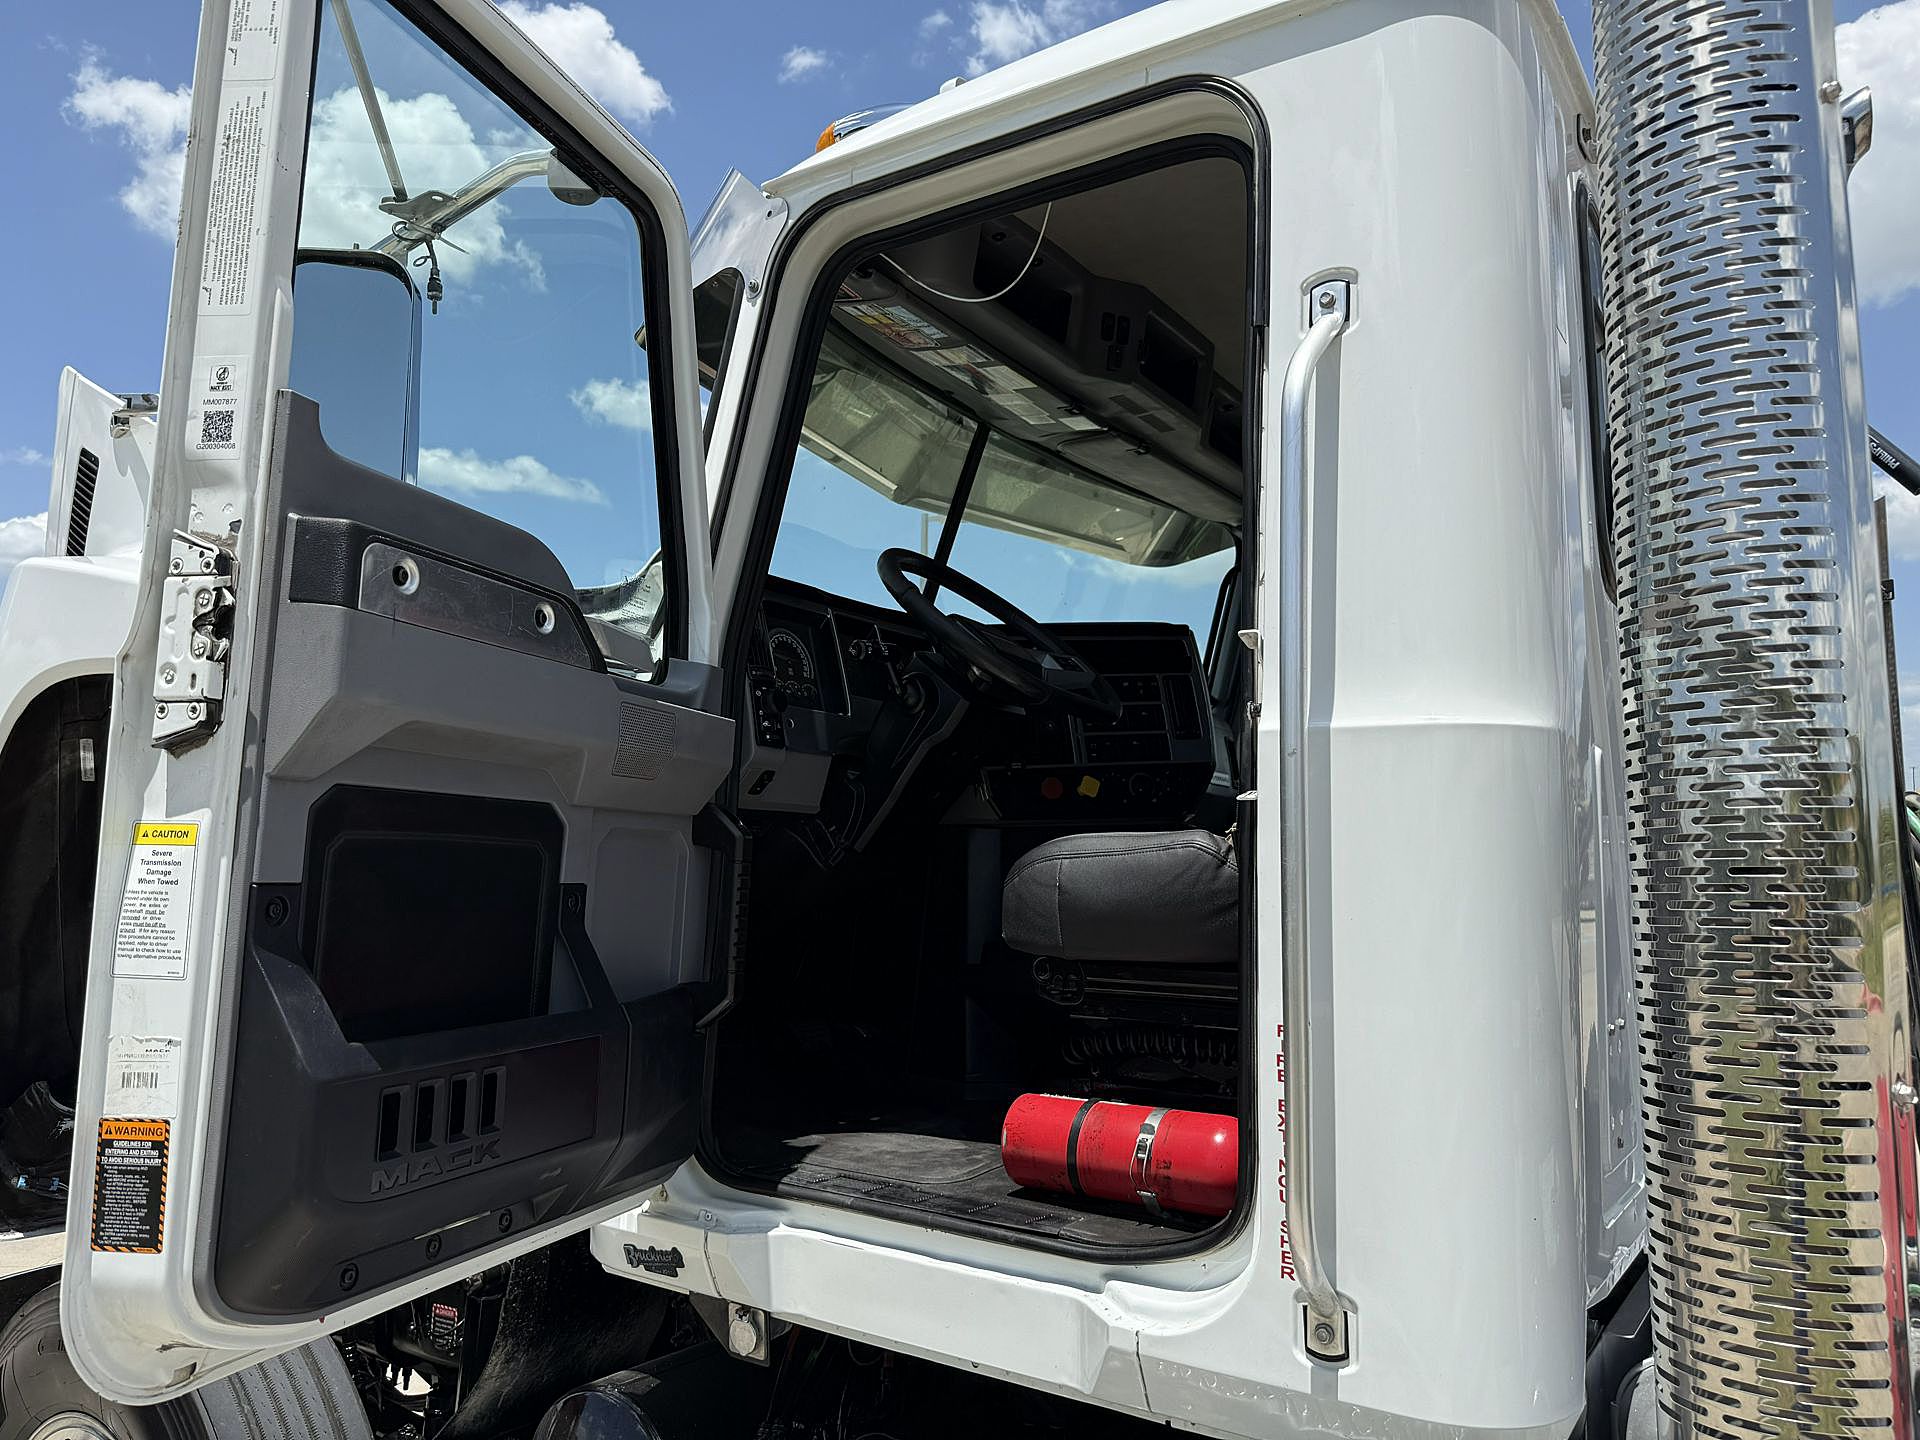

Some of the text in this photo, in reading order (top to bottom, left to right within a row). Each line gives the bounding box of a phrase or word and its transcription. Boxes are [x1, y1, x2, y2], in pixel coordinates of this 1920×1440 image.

[151, 829, 189, 839] CAUTION
[151, 849, 173, 857] Severe
[140, 858, 182, 867] Transmission
[146, 868, 172, 877] Damage
[138, 877, 179, 886] When Towed
[114, 1126, 163, 1137] WARNING
[370, 1138, 501, 1194] MACK
